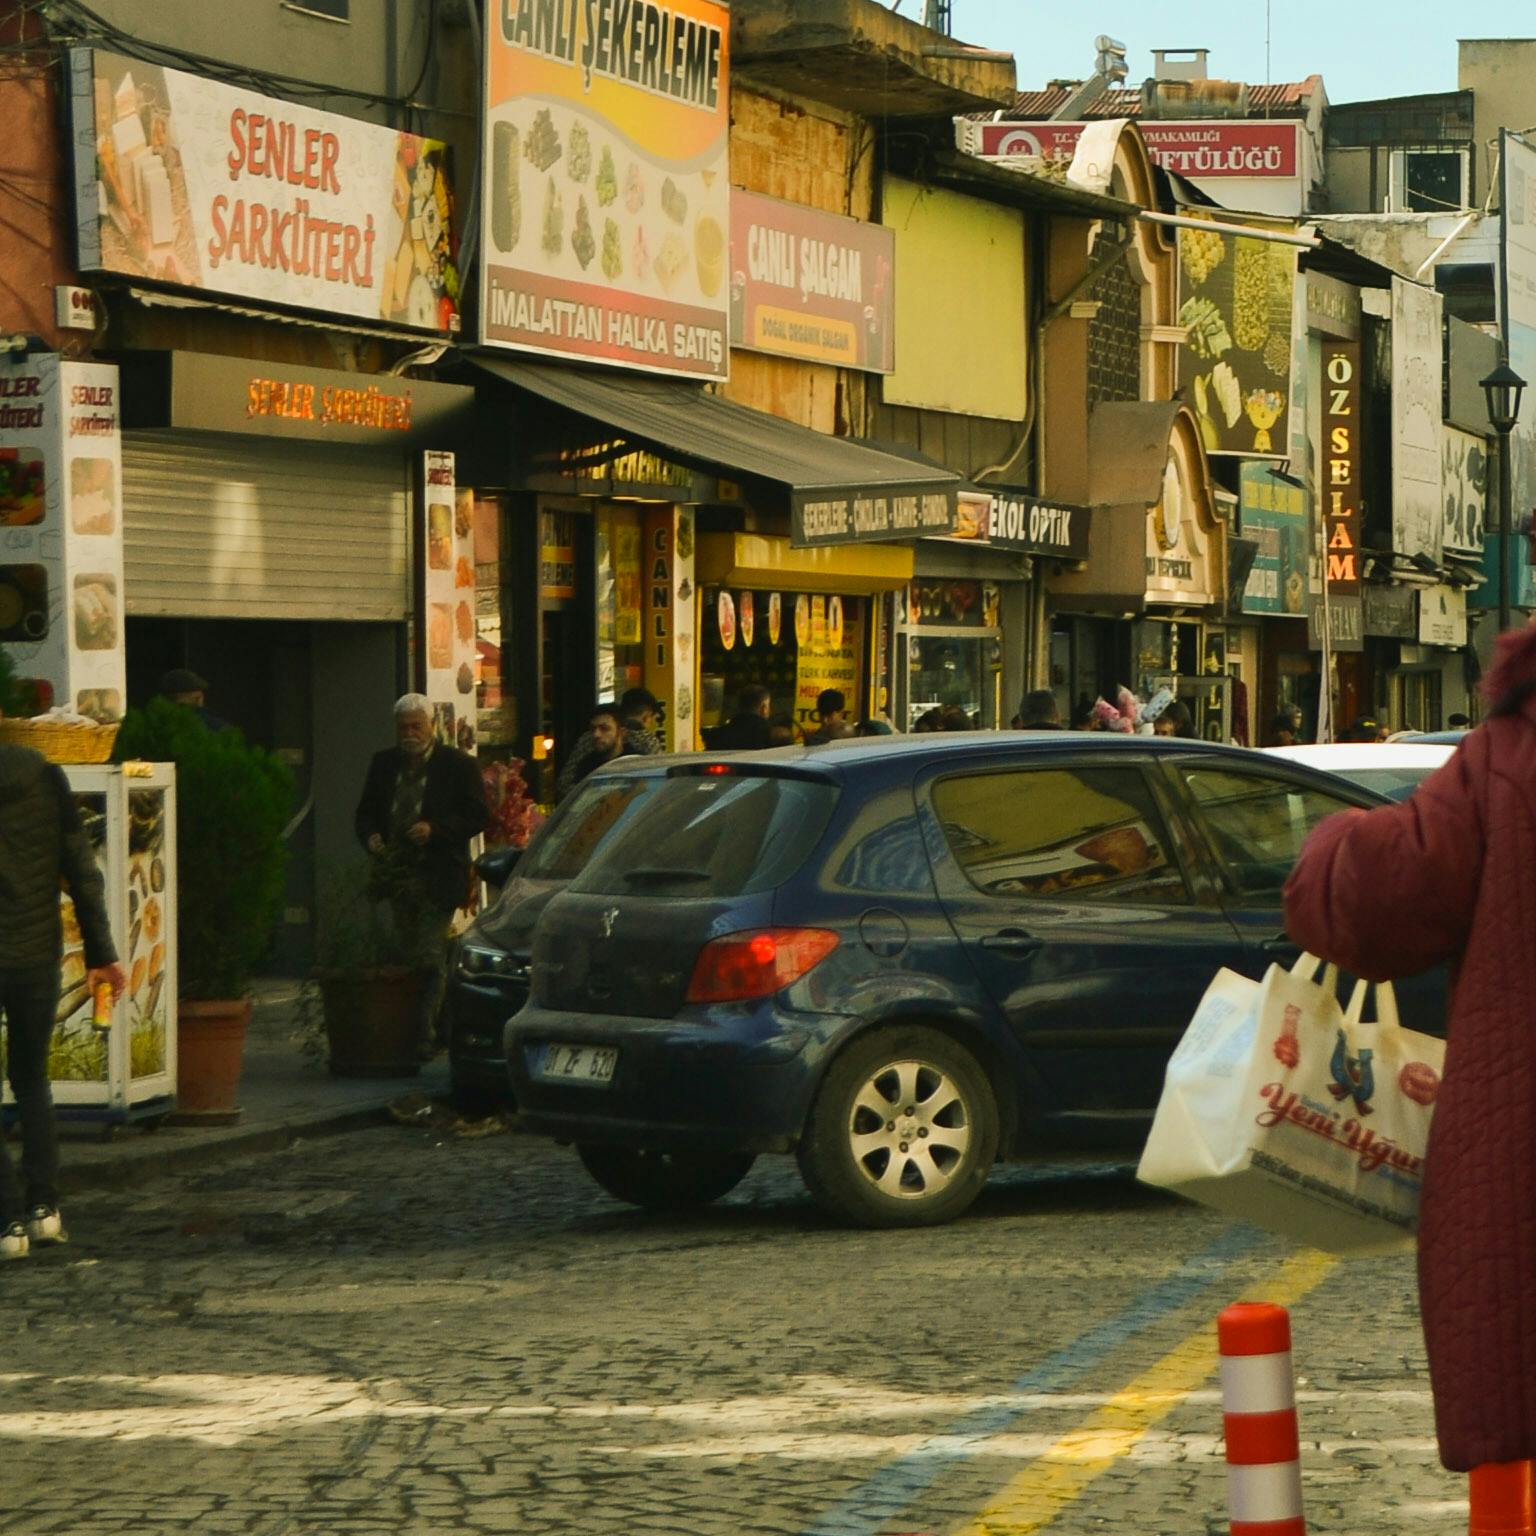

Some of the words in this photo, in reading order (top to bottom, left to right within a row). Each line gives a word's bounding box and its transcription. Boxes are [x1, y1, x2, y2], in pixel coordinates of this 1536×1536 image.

[228, 108, 340, 195] ŞENLER
[1155, 147, 1283, 171] ÜFTÜLÜĞÜ
[208, 194, 375, 288] ŞARKÜTERİ
[747, 224, 796, 288] CANLI
[491, 278, 602, 343] İMALATTAN
[607, 310, 669, 356] HALKA
[673, 323, 722, 373] SATIŞ
[246, 378, 314, 419] ŞENLER
[1327, 353, 1353, 416] ÖZ
[1029, 504, 1072, 547] OPTİK
[1327, 427, 1358, 581] SELAM
[653, 527, 669, 667] CANLI
[1255, 1082, 1341, 1135] Yeni
